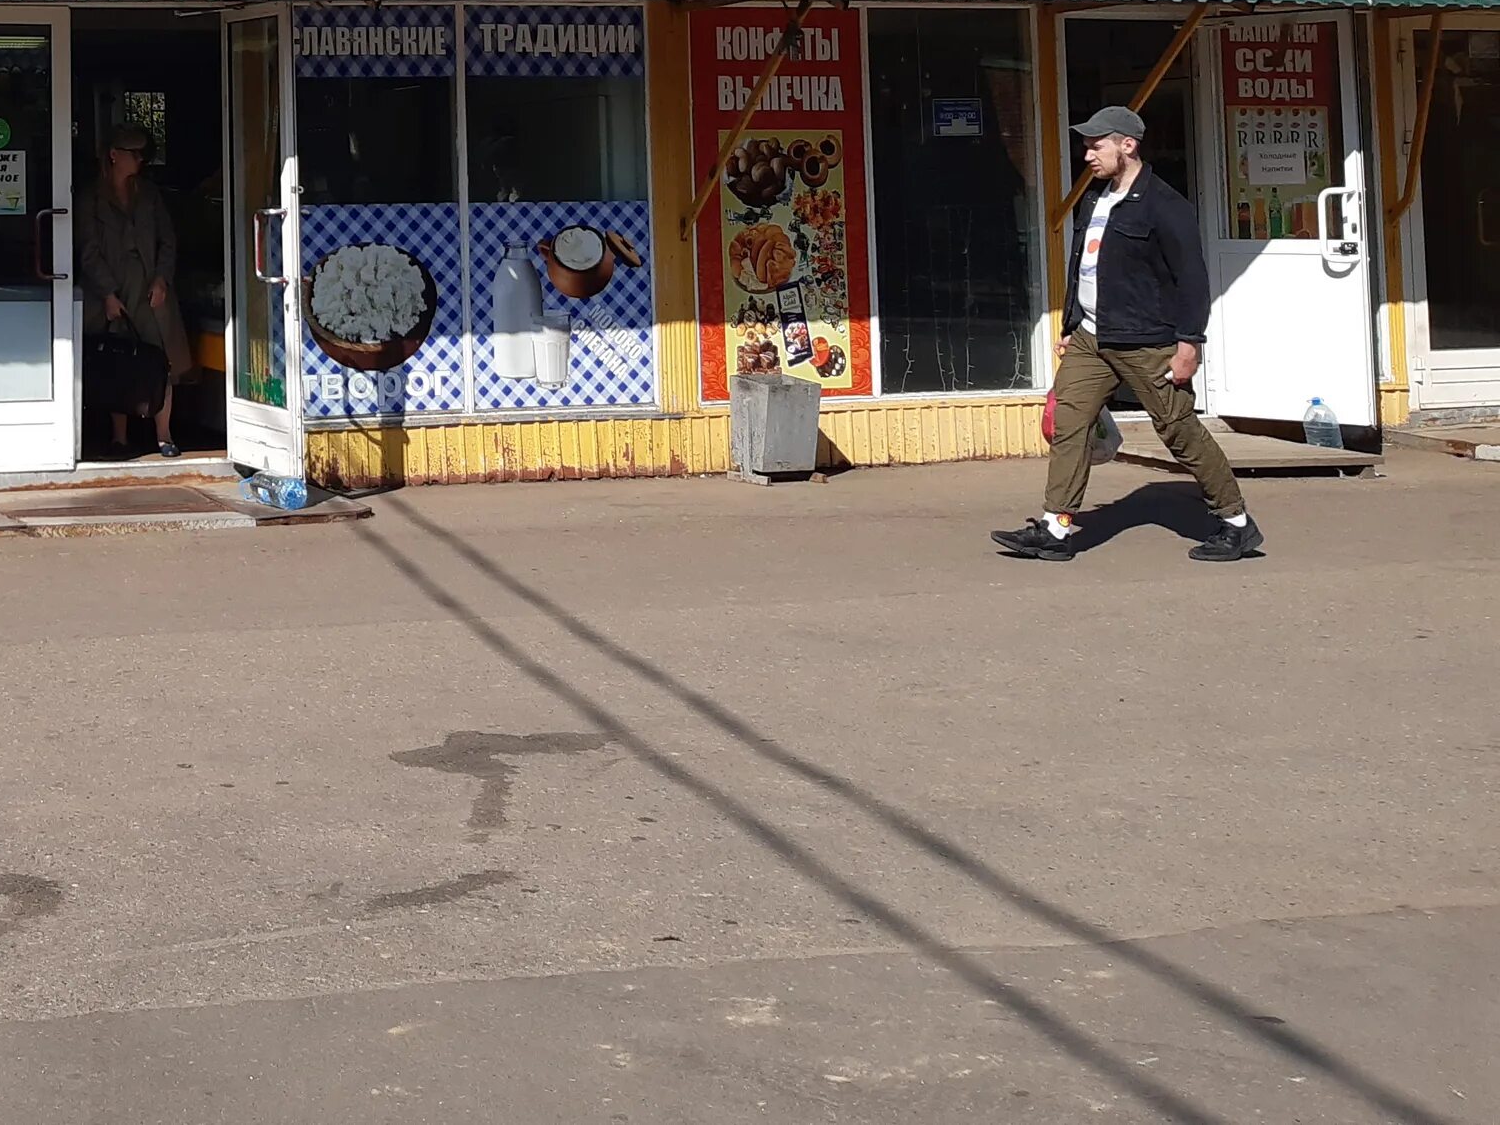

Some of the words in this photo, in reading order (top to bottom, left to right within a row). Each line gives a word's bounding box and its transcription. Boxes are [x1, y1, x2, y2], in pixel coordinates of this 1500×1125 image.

[479, 22, 636, 58] ТРАДИЦИИ
[716, 26, 839, 61] КОНФТЫ
[1229, 24, 1318, 43] НАПИКИ
[717, 75, 845, 111] ВЫПЕЧКА
[1238, 78, 1314, 101] ВОДЫ
[589, 304, 643, 359] МОЛОКО
[571, 320, 628, 380] СМЕТАНА
